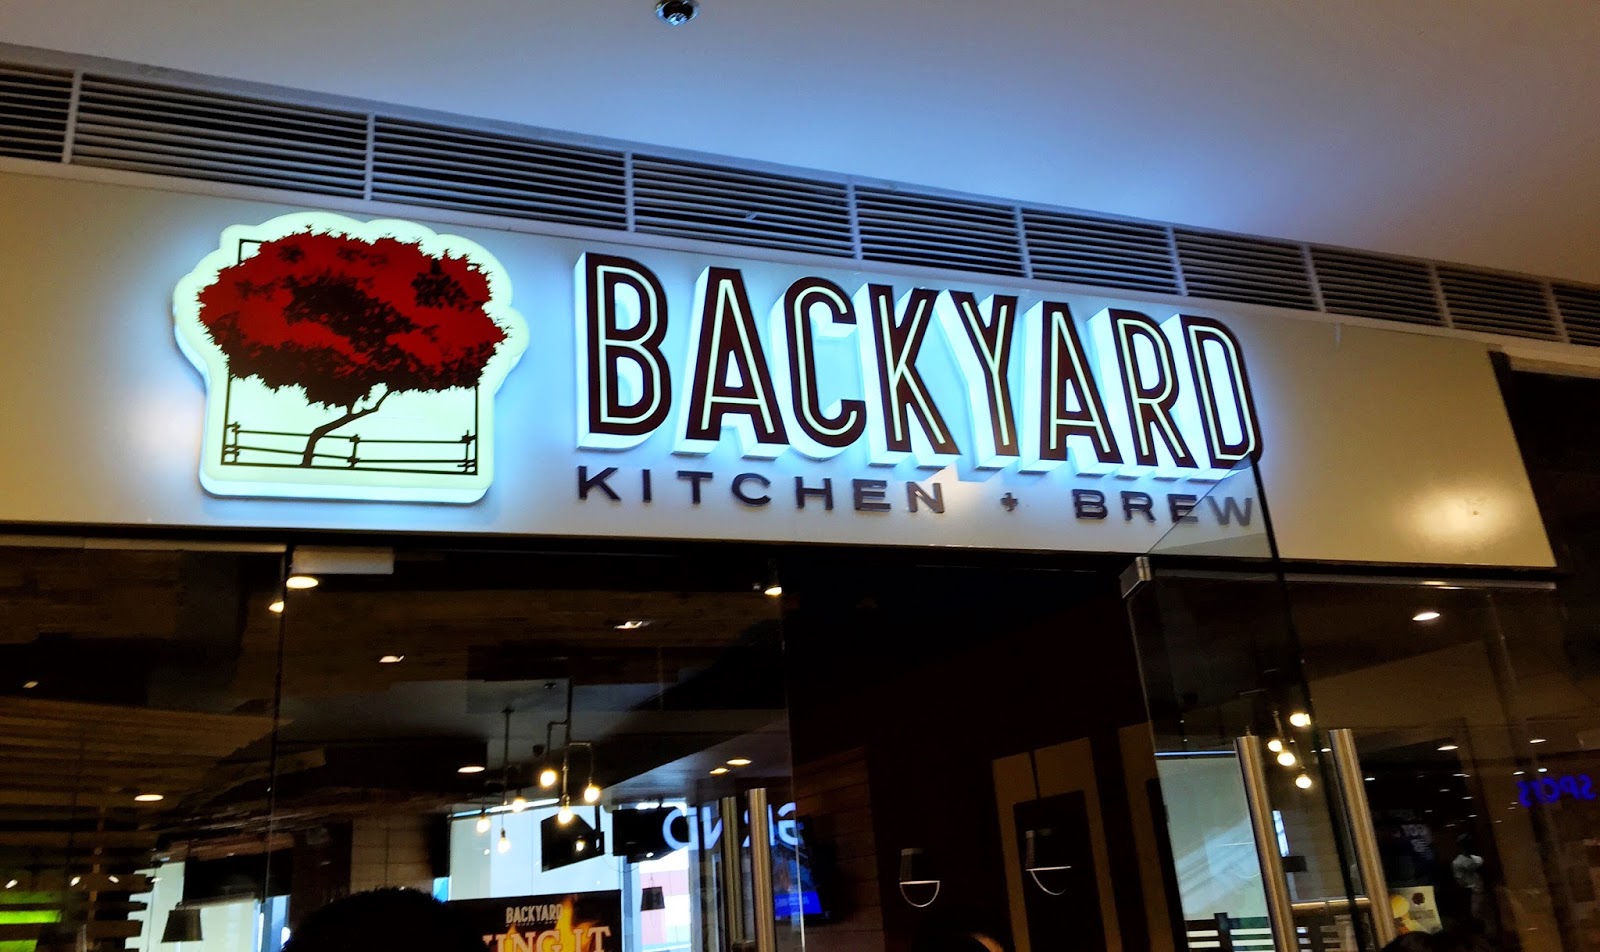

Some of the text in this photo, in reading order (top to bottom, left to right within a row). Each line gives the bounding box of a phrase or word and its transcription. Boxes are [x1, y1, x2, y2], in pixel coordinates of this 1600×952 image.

[583, 252, 1262, 469] BACKYARD
[576, 465, 1253, 527] KITCHEN + BREW
[505, 903, 562, 924] BACKYARD
[573, 926, 612, 952] IT
